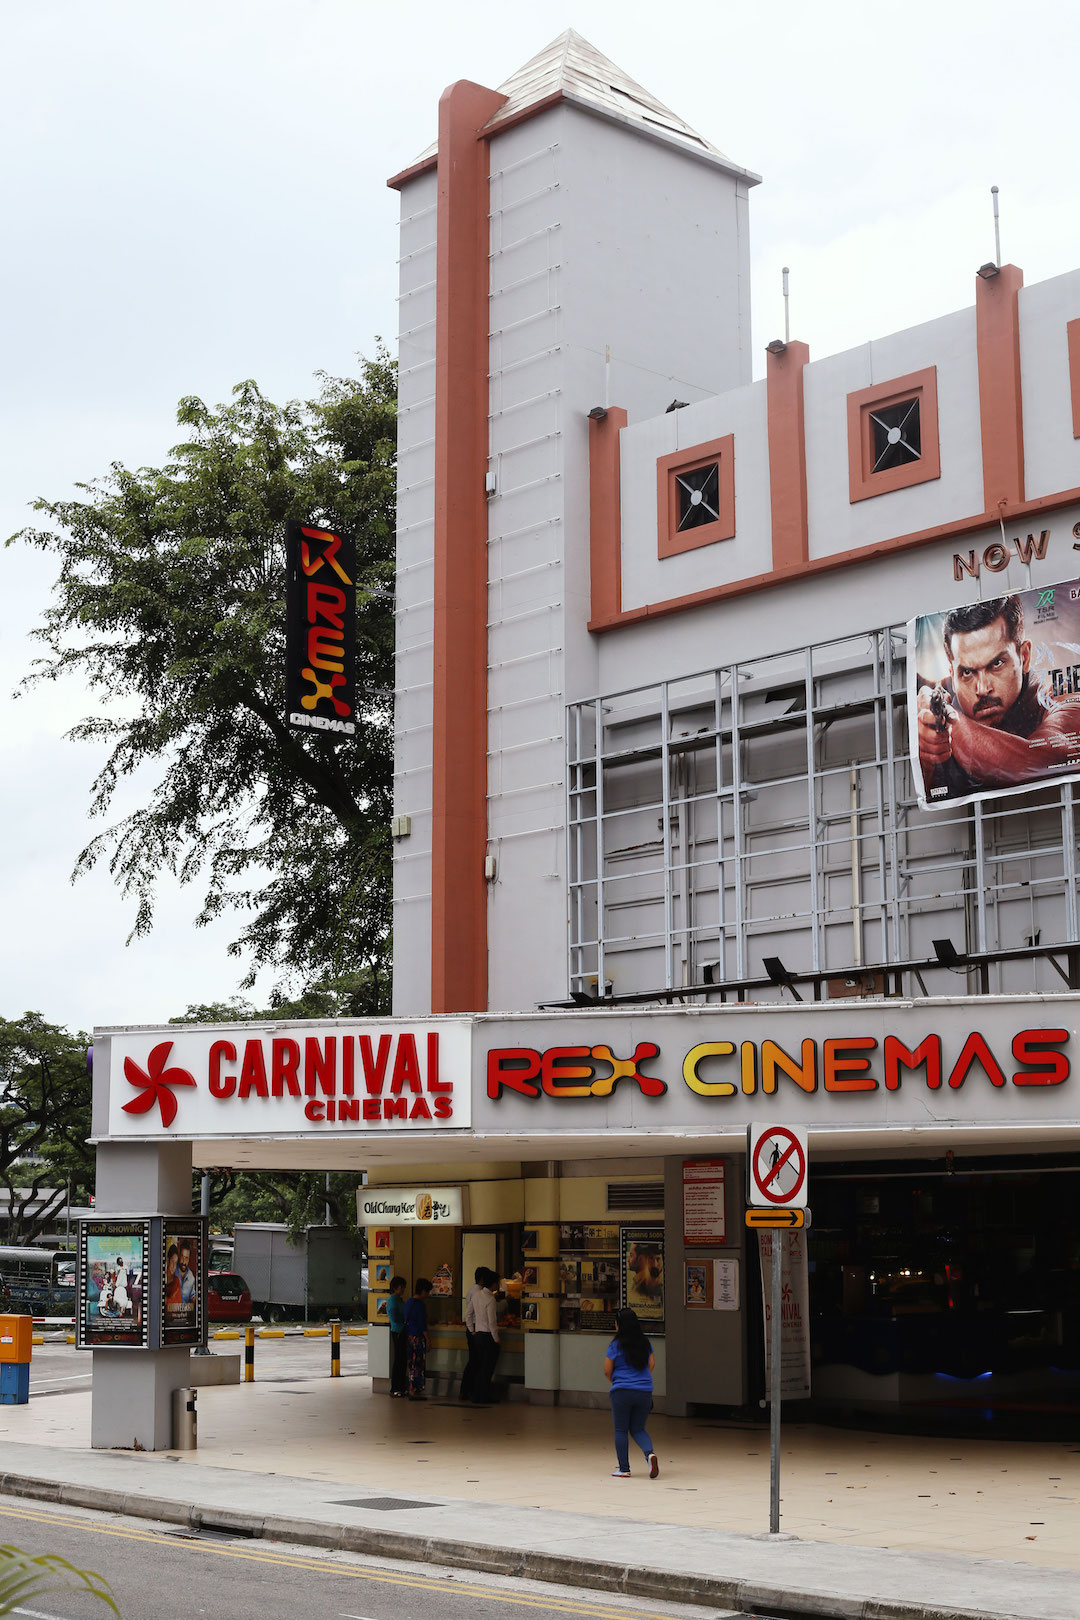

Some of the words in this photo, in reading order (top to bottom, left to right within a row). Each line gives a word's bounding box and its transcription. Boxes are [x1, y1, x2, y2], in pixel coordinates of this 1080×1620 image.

[953, 529, 1051, 582] NOW
[1036, 605, 1055, 614] TSR
[301, 581, 352, 717] REX
[289, 712, 356, 735] CINEMAS
[208, 1032, 454, 1099] CARNIVAL
[486, 1041, 668, 1100] REX
[682, 1028, 1070, 1098] CINEMAS
[304, 1096, 454, 1122] CINEMAS
[89, 1224, 107, 1233] NOW
[107, 1224, 143, 1233] SHOWING
[627, 1231, 648, 1239] COMING
[765, 1303, 802, 1321] CNIVAL
